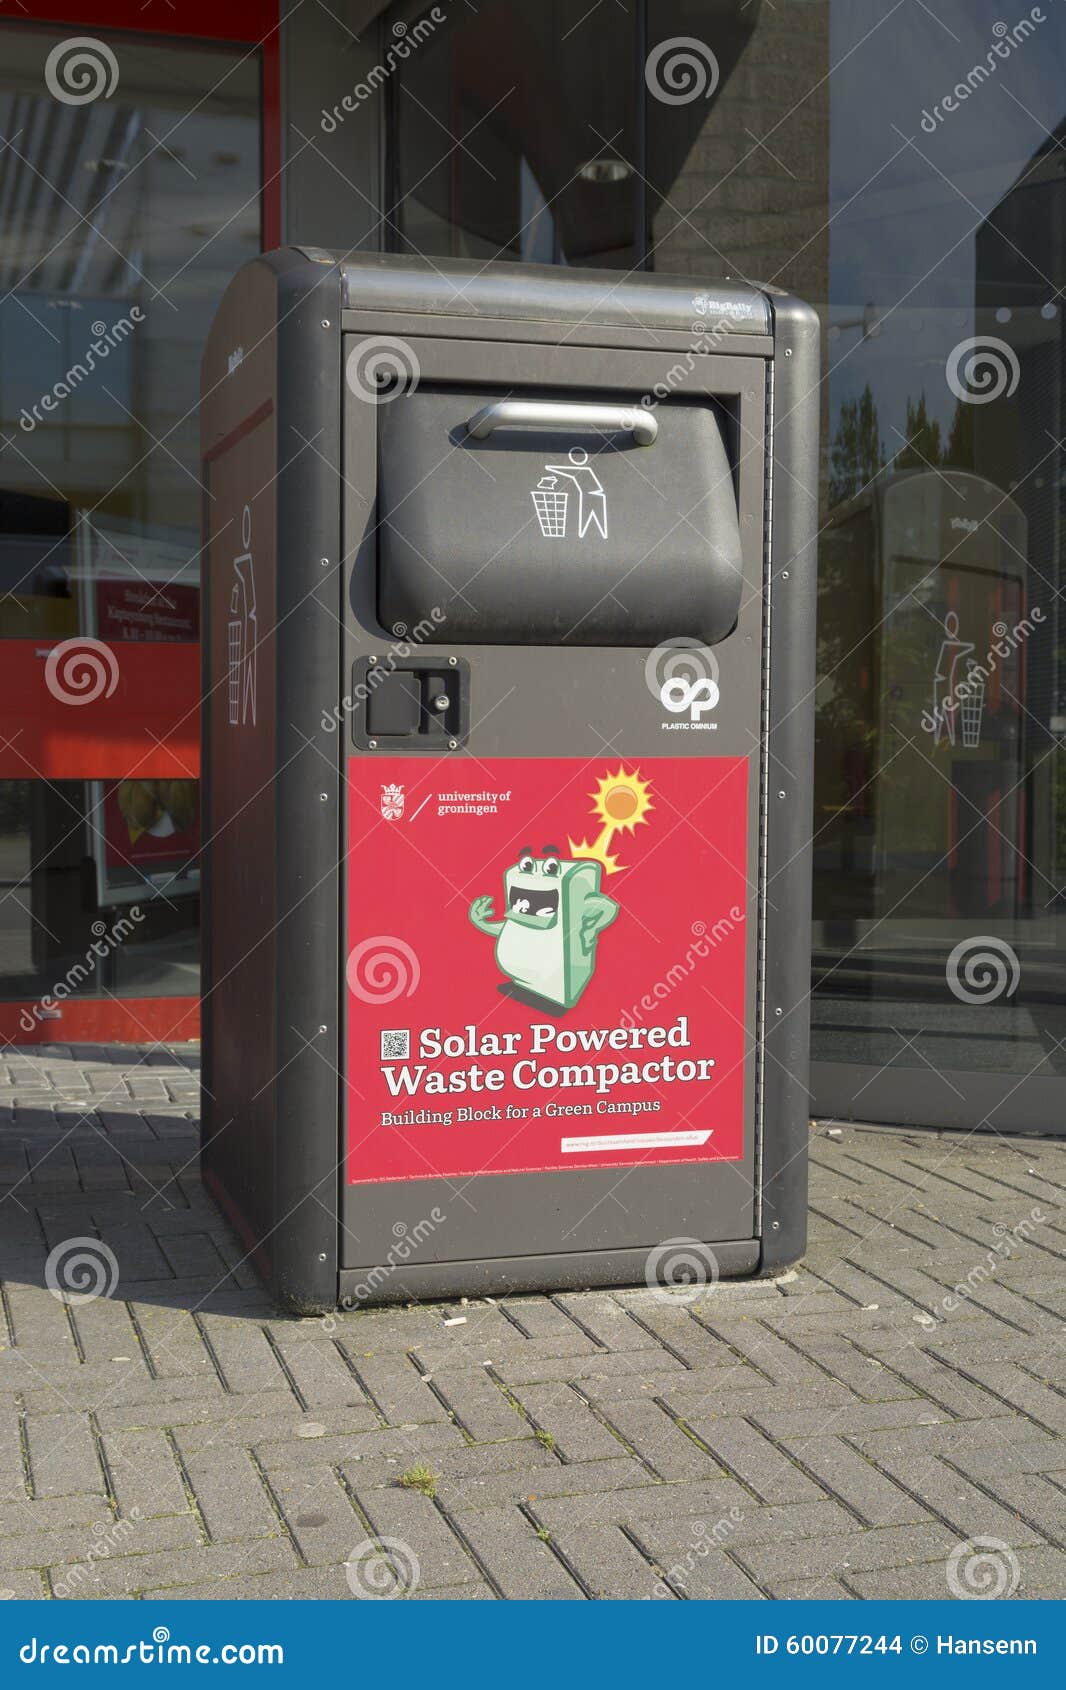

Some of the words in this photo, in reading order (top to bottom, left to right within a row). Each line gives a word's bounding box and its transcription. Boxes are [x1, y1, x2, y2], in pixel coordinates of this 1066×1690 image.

[438, 791, 498, 804] university
[499, 791, 512, 802] of
[438, 803, 497, 816] groningen
[419, 1025, 522, 1059] Solar
[530, 1016, 691, 1055] Powered
[380, 1064, 506, 1097] Waste
[512, 1055, 716, 1094] Compactor
[381, 1109, 453, 1127] Building
[457, 1106, 502, 1122] Block
[505, 1105, 530, 1120] for
[532, 1107, 541, 1119] a
[545, 1101, 593, 1118] Green
[596, 1099, 662, 1116] Campus
